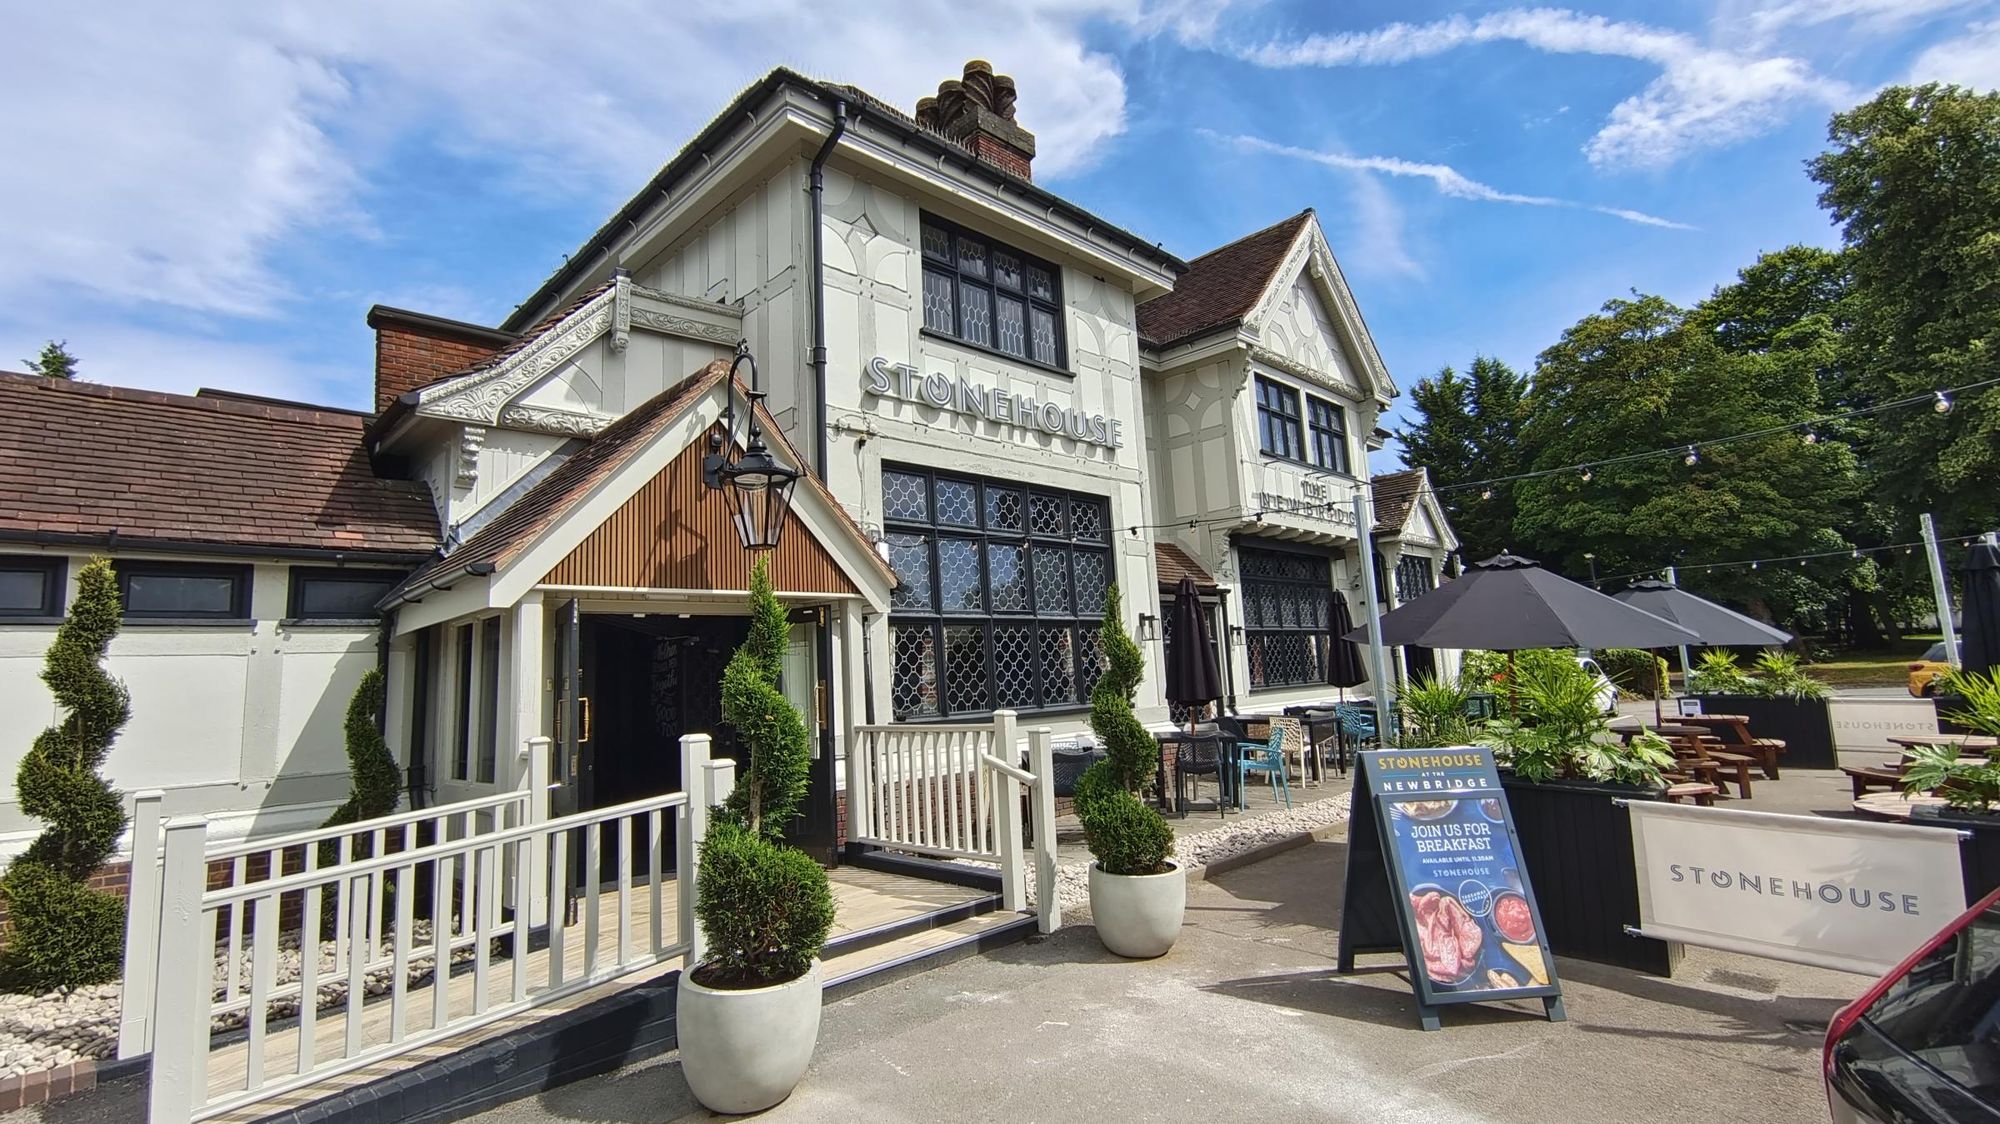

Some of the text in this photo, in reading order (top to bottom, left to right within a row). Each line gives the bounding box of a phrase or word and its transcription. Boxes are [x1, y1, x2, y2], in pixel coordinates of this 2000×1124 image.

[866, 356, 1124, 449] STONEHOUSE
[1301, 481, 1327, 500] THE
[1259, 492, 1356, 525] NEWBRDG
[1378, 754, 1483, 770] STONEHOUSE
[1383, 778, 1488, 791] NEWBRIDGE
[1411, 823, 1491, 838] JOIN US FOR
[1416, 837, 1491, 853] BREAKFAST
[1433, 868, 1490, 877] STONEHOUSE
[1669, 864, 1920, 916] STONEHOUSE
